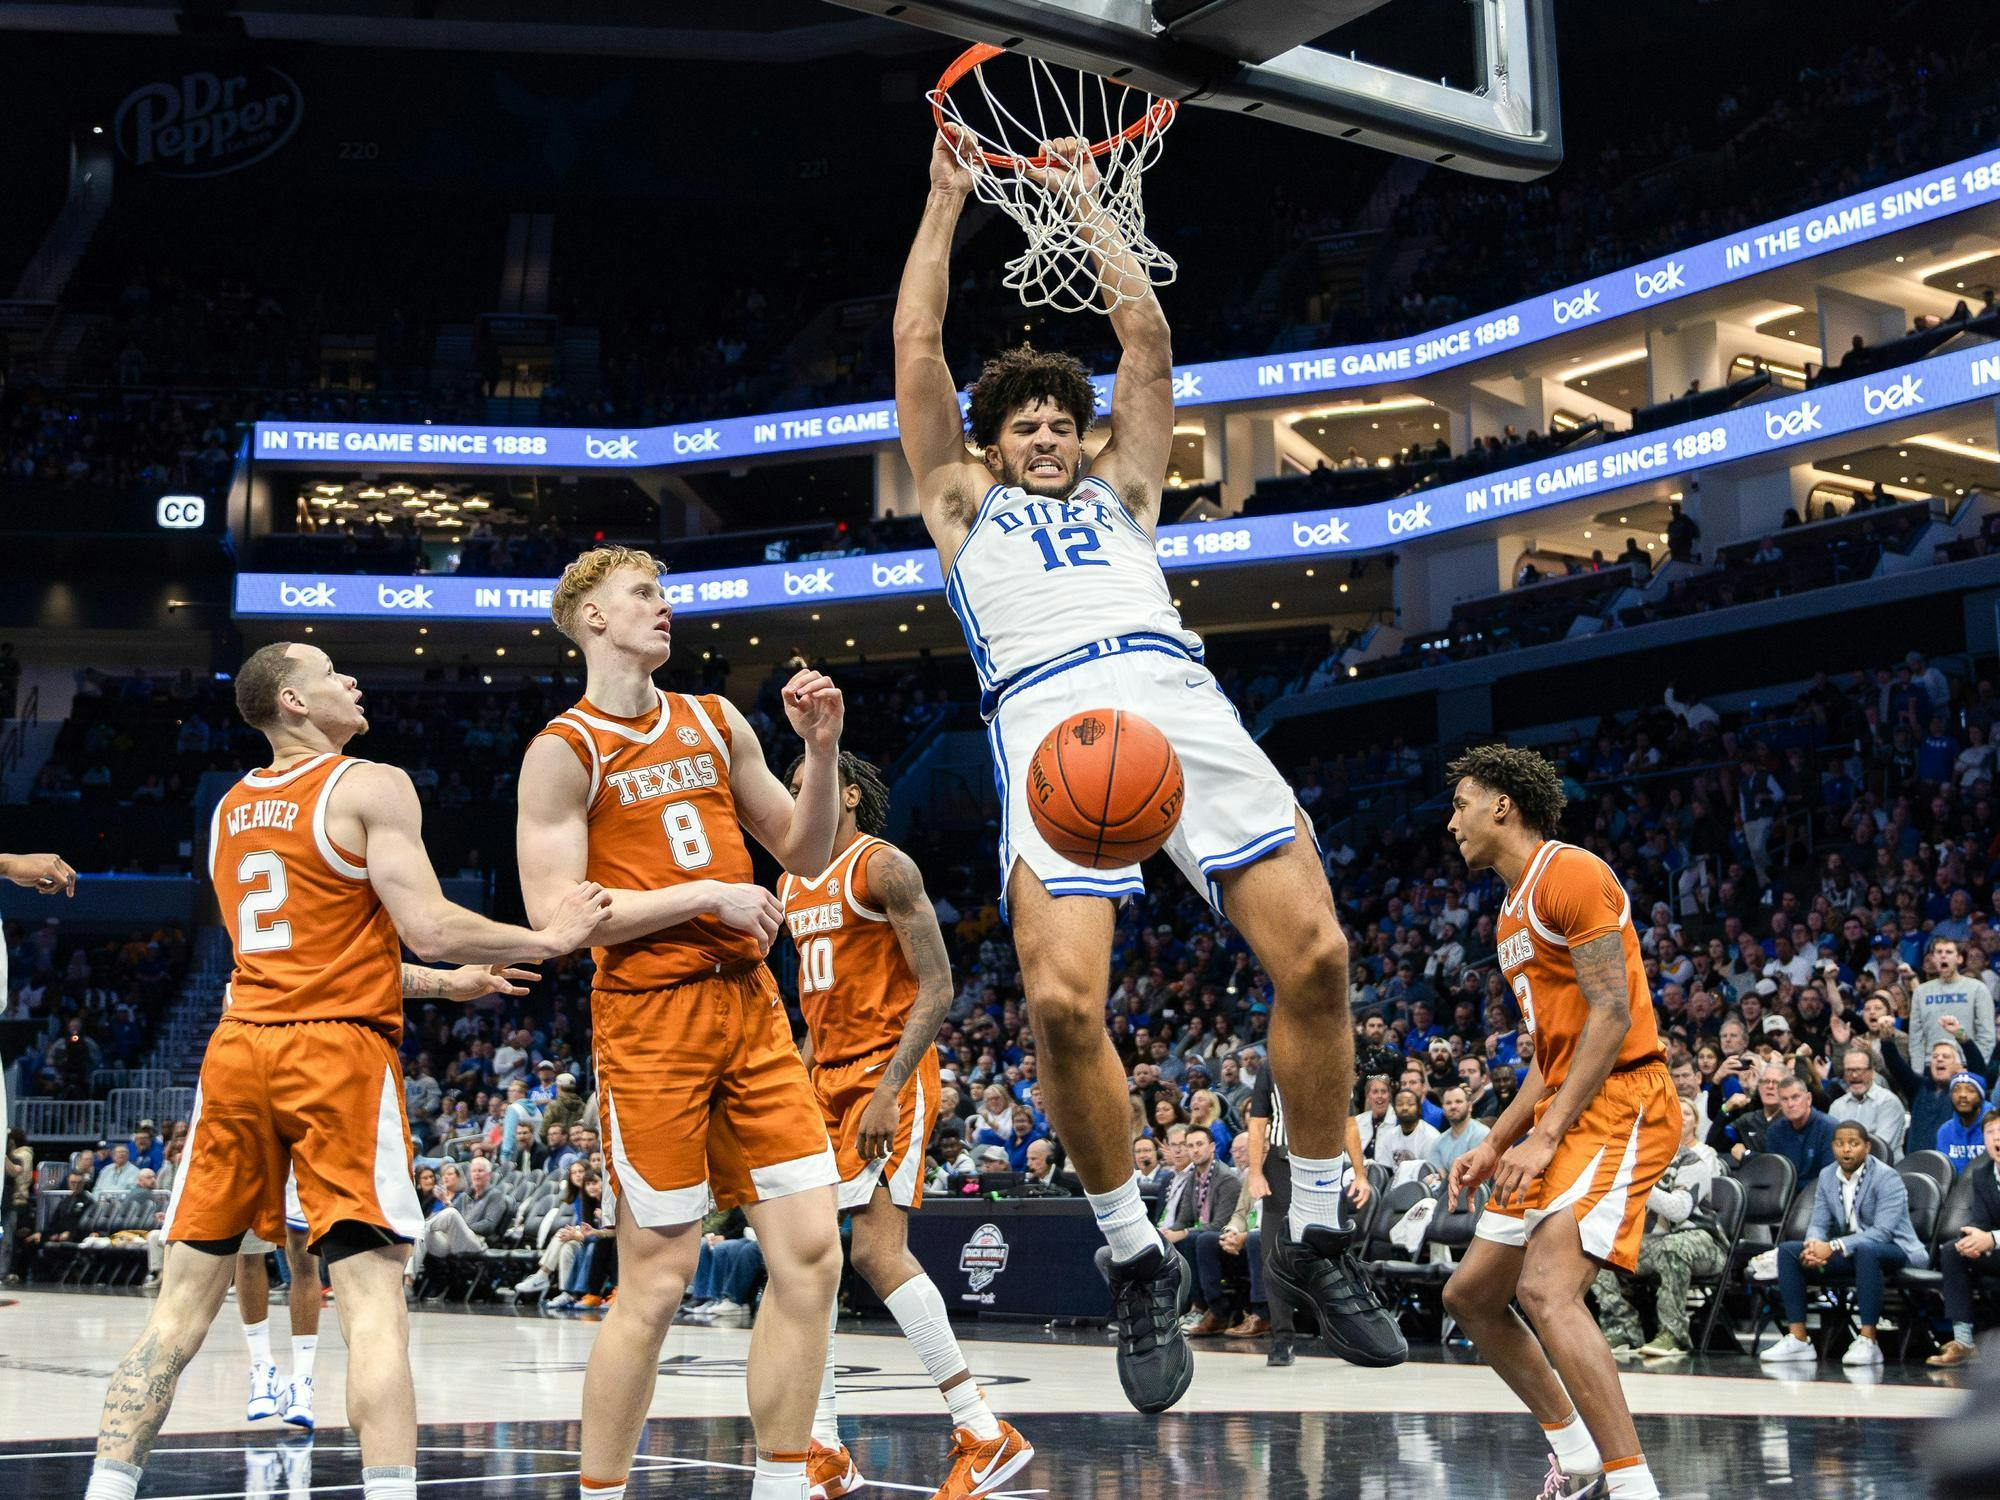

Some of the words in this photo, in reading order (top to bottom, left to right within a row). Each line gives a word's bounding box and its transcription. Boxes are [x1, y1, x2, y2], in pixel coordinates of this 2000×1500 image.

[182, 71, 250, 120] Dr
[114, 82, 291, 166] Pepper
[338, 141, 379, 160] 220
[1725, 242, 1750, 269] IN
[1754, 226, 1801, 259] THE
[1804, 202, 1877, 244] GAME
[1881, 176, 1957, 221] SINCE
[1634, 261, 1686, 299] belk
[1553, 288, 1601, 324] belk
[1258, 364, 1284, 386] IN
[1288, 357, 1337, 382] THE
[1340, 348, 1411, 376] GAME
[1415, 330, 1472, 365] SINCE
[1474, 315, 1520, 347] 1888
[1971, 356, 2000, 387] IN
[1863, 374, 1925, 416] belk
[754, 424, 777, 444] IN
[781, 418, 823, 439] THE
[826, 410, 890, 435] GAME
[1765, 401, 1823, 440] belk
[262, 431, 288, 449] IN
[293, 431, 340, 451] THE
[344, 432, 413, 453] GAME
[418, 434, 488, 455] SINCE
[492, 436, 548, 455] 1888
[585, 434, 639, 460] belk
[673, 428, 721, 455] belk
[1465, 489, 1487, 514] IN
[1491, 477, 1532, 507] THE
[1535, 460, 1598, 496] GAME
[1602, 442, 1668, 479] SINCE
[1672, 428, 1727, 461] 1888
[165, 503, 198, 522] CC
[991, 500, 1114, 535] DUKE
[1387, 501, 1433, 535] belk
[1031, 527, 1112, 572] 12
[1193, 530, 1251, 555] 1888
[1292, 517, 1350, 547] belk
[698, 579, 749, 602] 1888
[784, 568, 834, 596] belk
[872, 559, 924, 588] belk
[280, 582, 336, 607] belk
[378, 584, 434, 609] belk
[475, 588, 501, 608] IN
[506, 589, 554, 609] THE
[605, 753, 719, 806] TEXAS
[226, 800, 299, 838] WEAVER
[660, 801, 713, 872] 8
[238, 850, 292, 954] 2
[787, 901, 844, 939] TEXAS
[801, 937, 835, 993] 10
[1497, 927, 1535, 973] EXAS
[1925, 992, 1968, 1005] DUKE
